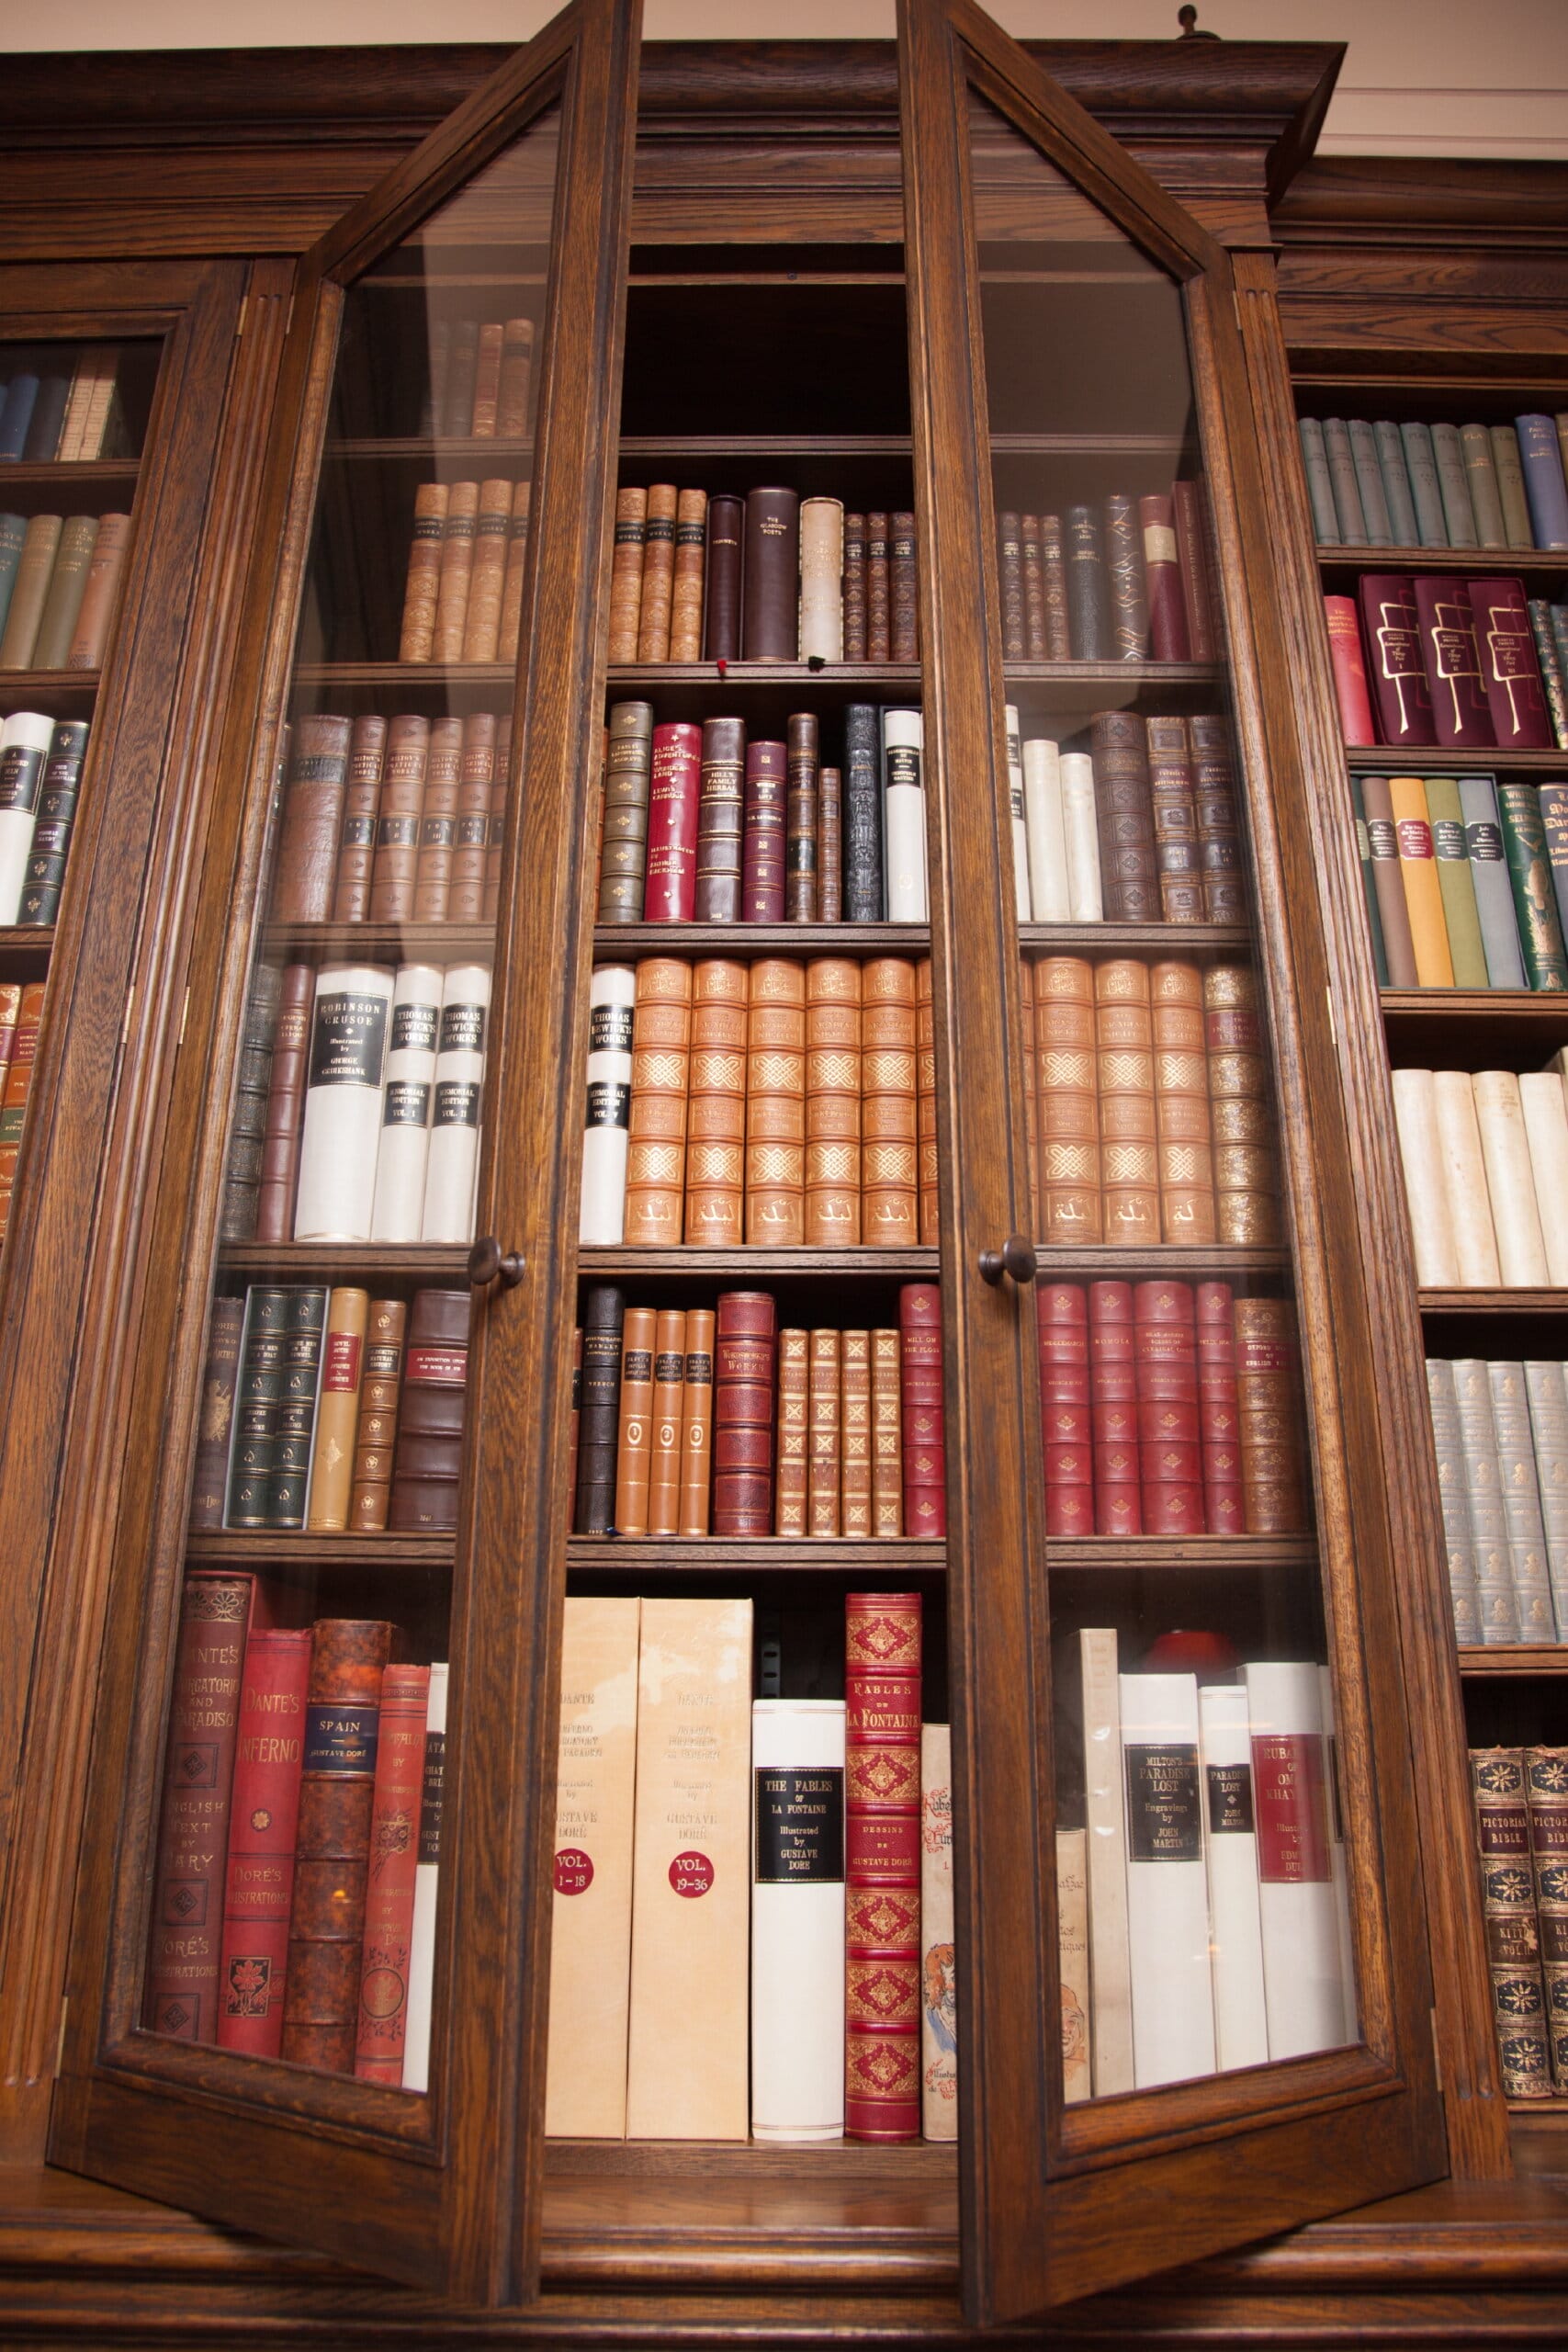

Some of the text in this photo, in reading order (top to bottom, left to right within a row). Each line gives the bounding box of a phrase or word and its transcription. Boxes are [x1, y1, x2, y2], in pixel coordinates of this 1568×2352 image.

[321, 1001, 382, 1015] ROBINSON
[324, 1014, 374, 1028] CRUSOE
[398, 1012, 434, 1023] THOMAS
[446, 1012, 480, 1023] THOMAS
[594, 1012, 631, 1023] THOMAS
[399, 1033, 430, 1045] WORKS
[446, 1034, 478, 1046] WORKS
[595, 1034, 627, 1046] WORKS
[853, 1681, 911, 1697] FABLES
[244, 1687, 300, 1714] DANTE'S
[846, 1706, 919, 1729] LA FONTAINE
[319, 1719, 362, 1736] SPAIN
[236, 1732, 301, 1765] INFERNO
[310, 1747, 345, 1759] GUSTAVE
[1145, 1756, 1184, 1767] MILTON'S
[1138, 1768, 1191, 1781] PARADISE
[764, 1780, 833, 1792] THE FABLES
[1152, 1780, 1180, 1792] LOST
[1220, 1782, 1241, 1793] LOST
[795, 1793, 806, 1803] OF
[772, 1804, 828, 1815] LA FONTAINE
[1145, 1802, 1189, 1815] Engravings
[667, 1811, 718, 1826] GUSTAVE
[1161, 1814, 1175, 1825] by
[1482, 1815, 1527, 1829] PICTORIAL
[780, 1824, 819, 1836] Illustrated
[862, 1825, 905, 1835] DESSINS
[1157, 1827, 1179, 1838] JOHN
[794, 1836, 806, 1848] by
[1152, 1838, 1184, 1849] MARTIN
[1491, 1832, 1524, 1844] BIBLE.
[781, 1849, 819, 1860] GUSTAVE
[556, 1853, 588, 1869] VOL.
[675, 1857, 706, 1873] VOL.
[852, 1855, 889, 1868] GUSTAVE
[676, 1877, 709, 1894] 19-36
